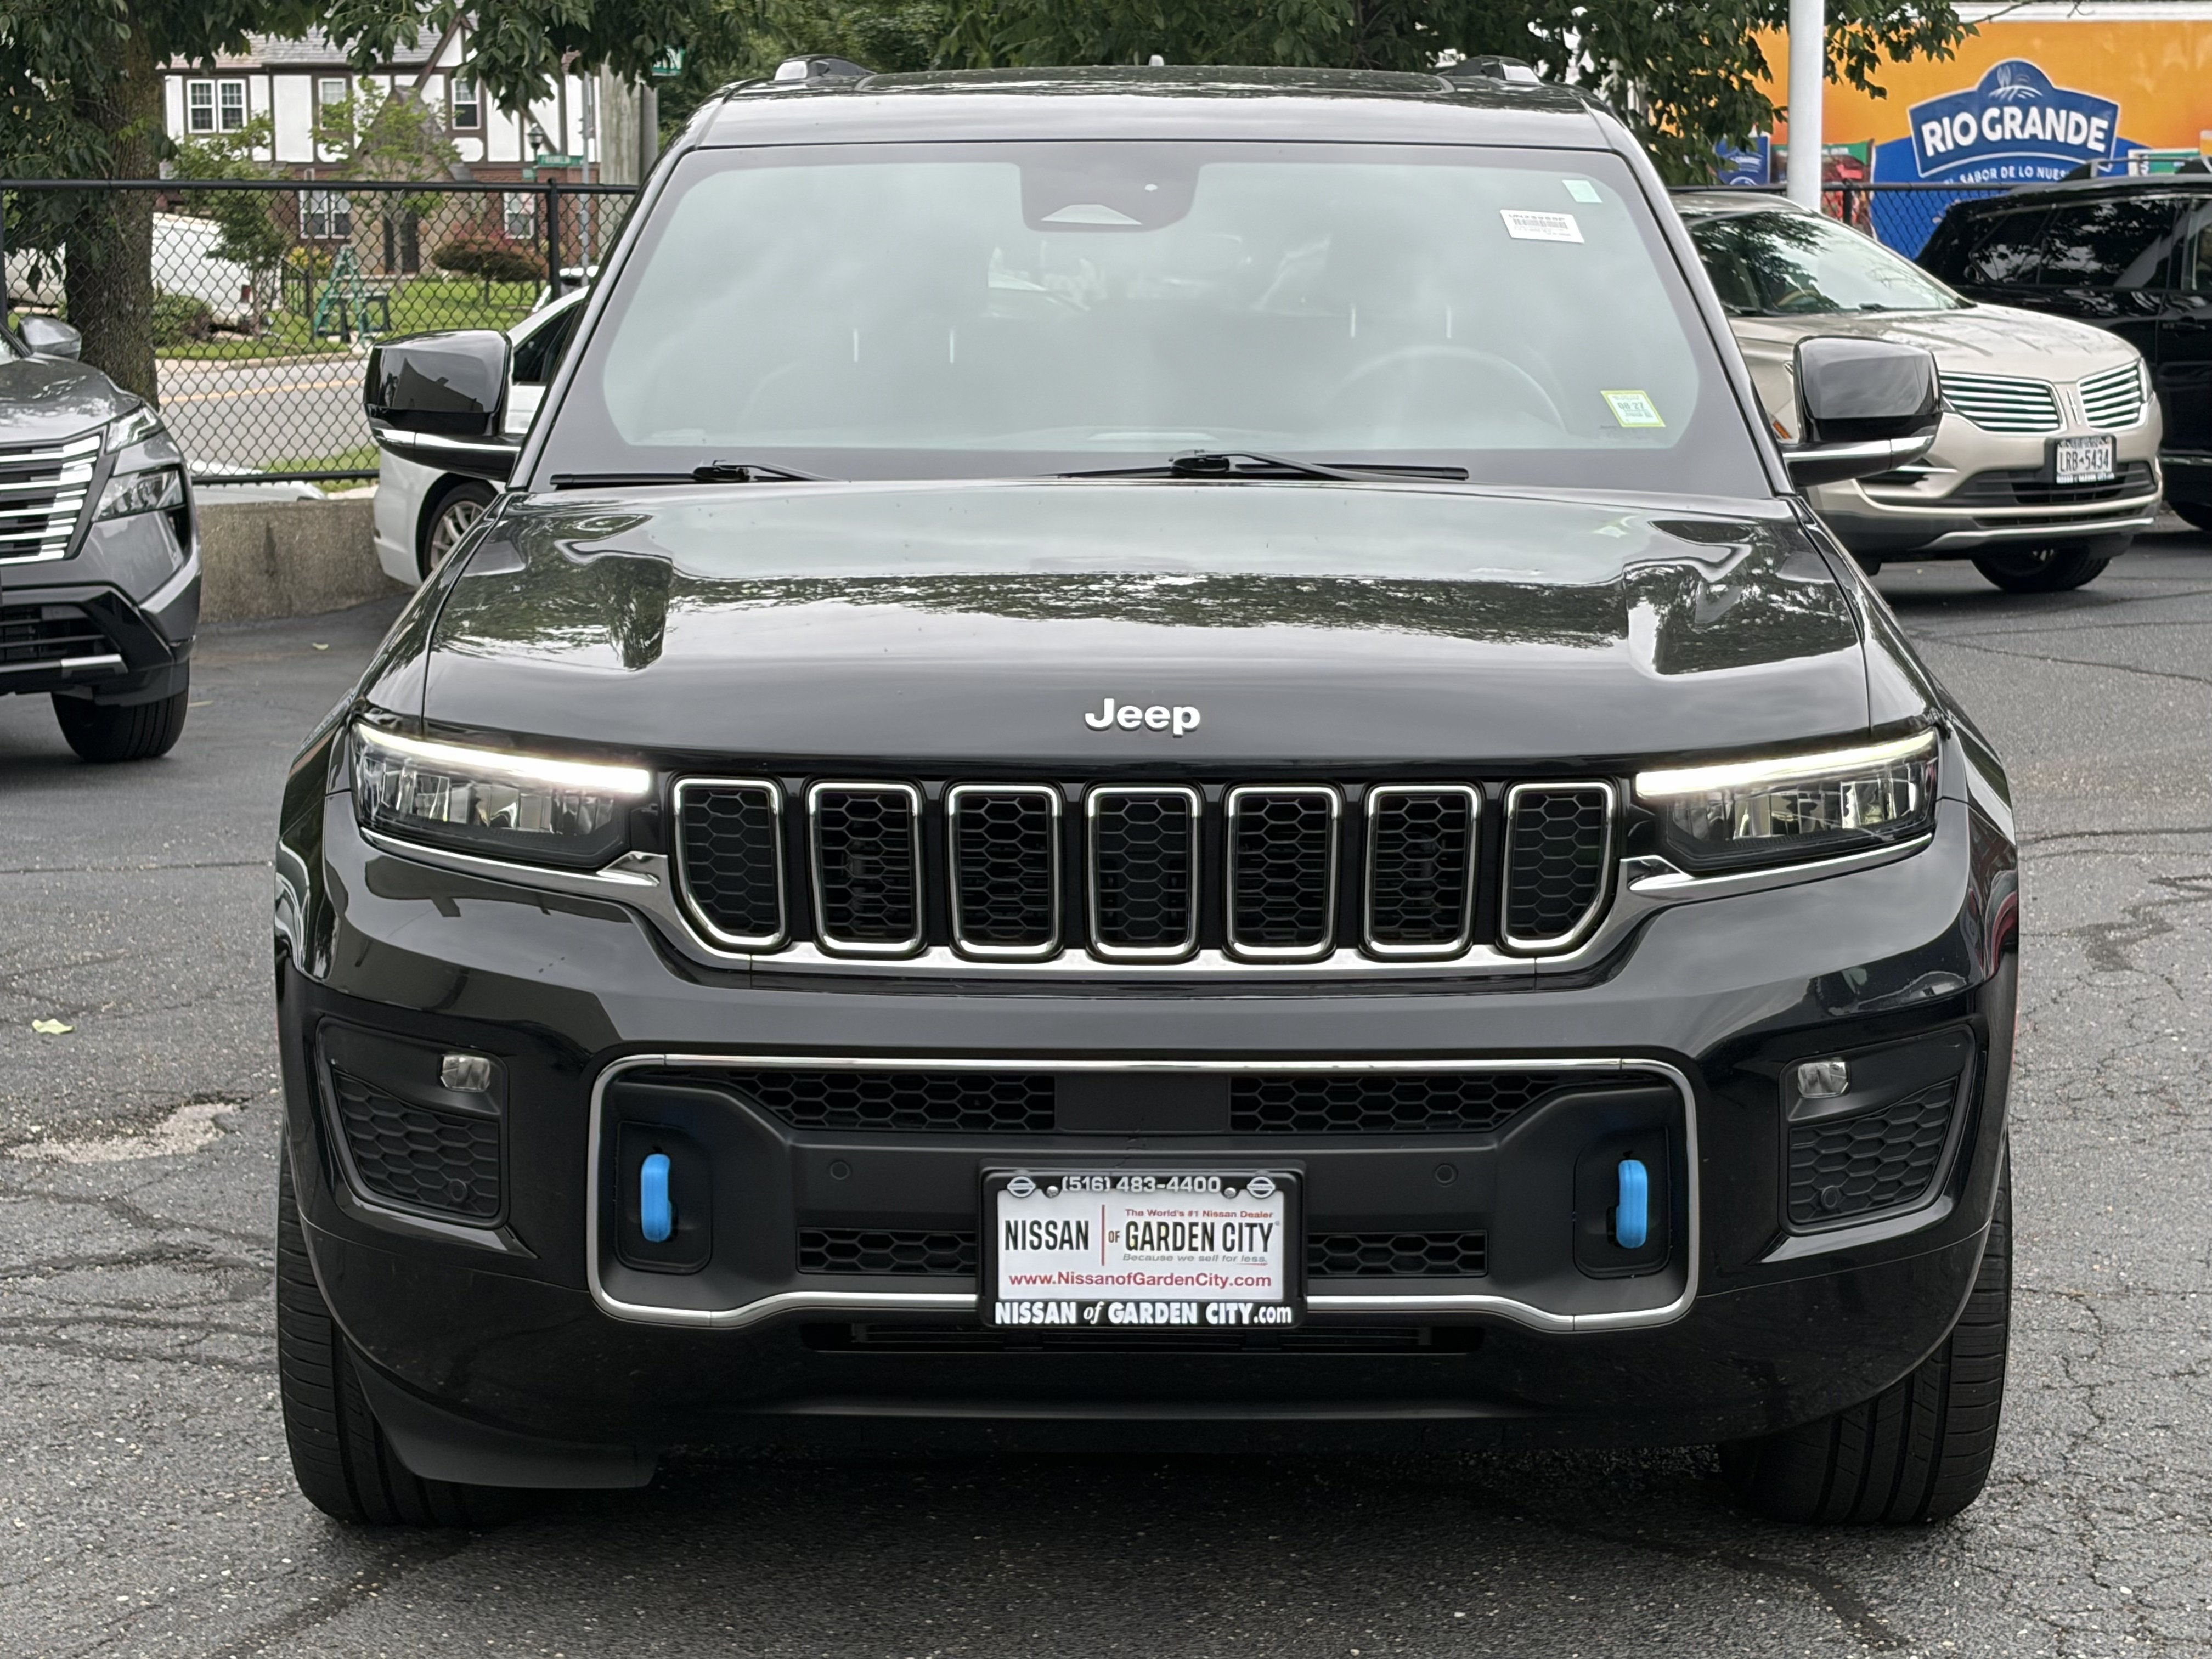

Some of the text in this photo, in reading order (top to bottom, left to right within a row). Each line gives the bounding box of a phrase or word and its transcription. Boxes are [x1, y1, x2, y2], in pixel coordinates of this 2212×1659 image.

[1922, 106, 2108, 157] RIO GRANDE
[1960, 168, 1997, 184] SABOR
[2001, 166, 2016, 179] DE
[2019, 166, 2034, 178] LO
[2037, 166, 2068, 181] NUES
[2060, 449, 2109, 472] LRB 5434
[1085, 698, 1200, 736] Jeep
[1062, 1176, 1221, 1193] (516) 483-4400
[1240, 1210, 1273, 1218] Dealer
[1005, 1220, 1273, 1252] NISSAN OF GARDEN CITY
[1123, 1254, 1173, 1262] Because
[1009, 1271, 1272, 1289] www.NissanofGardenCity.com
[995, 1301, 1292, 1324] NISSAN of GARDEN CITY.com
